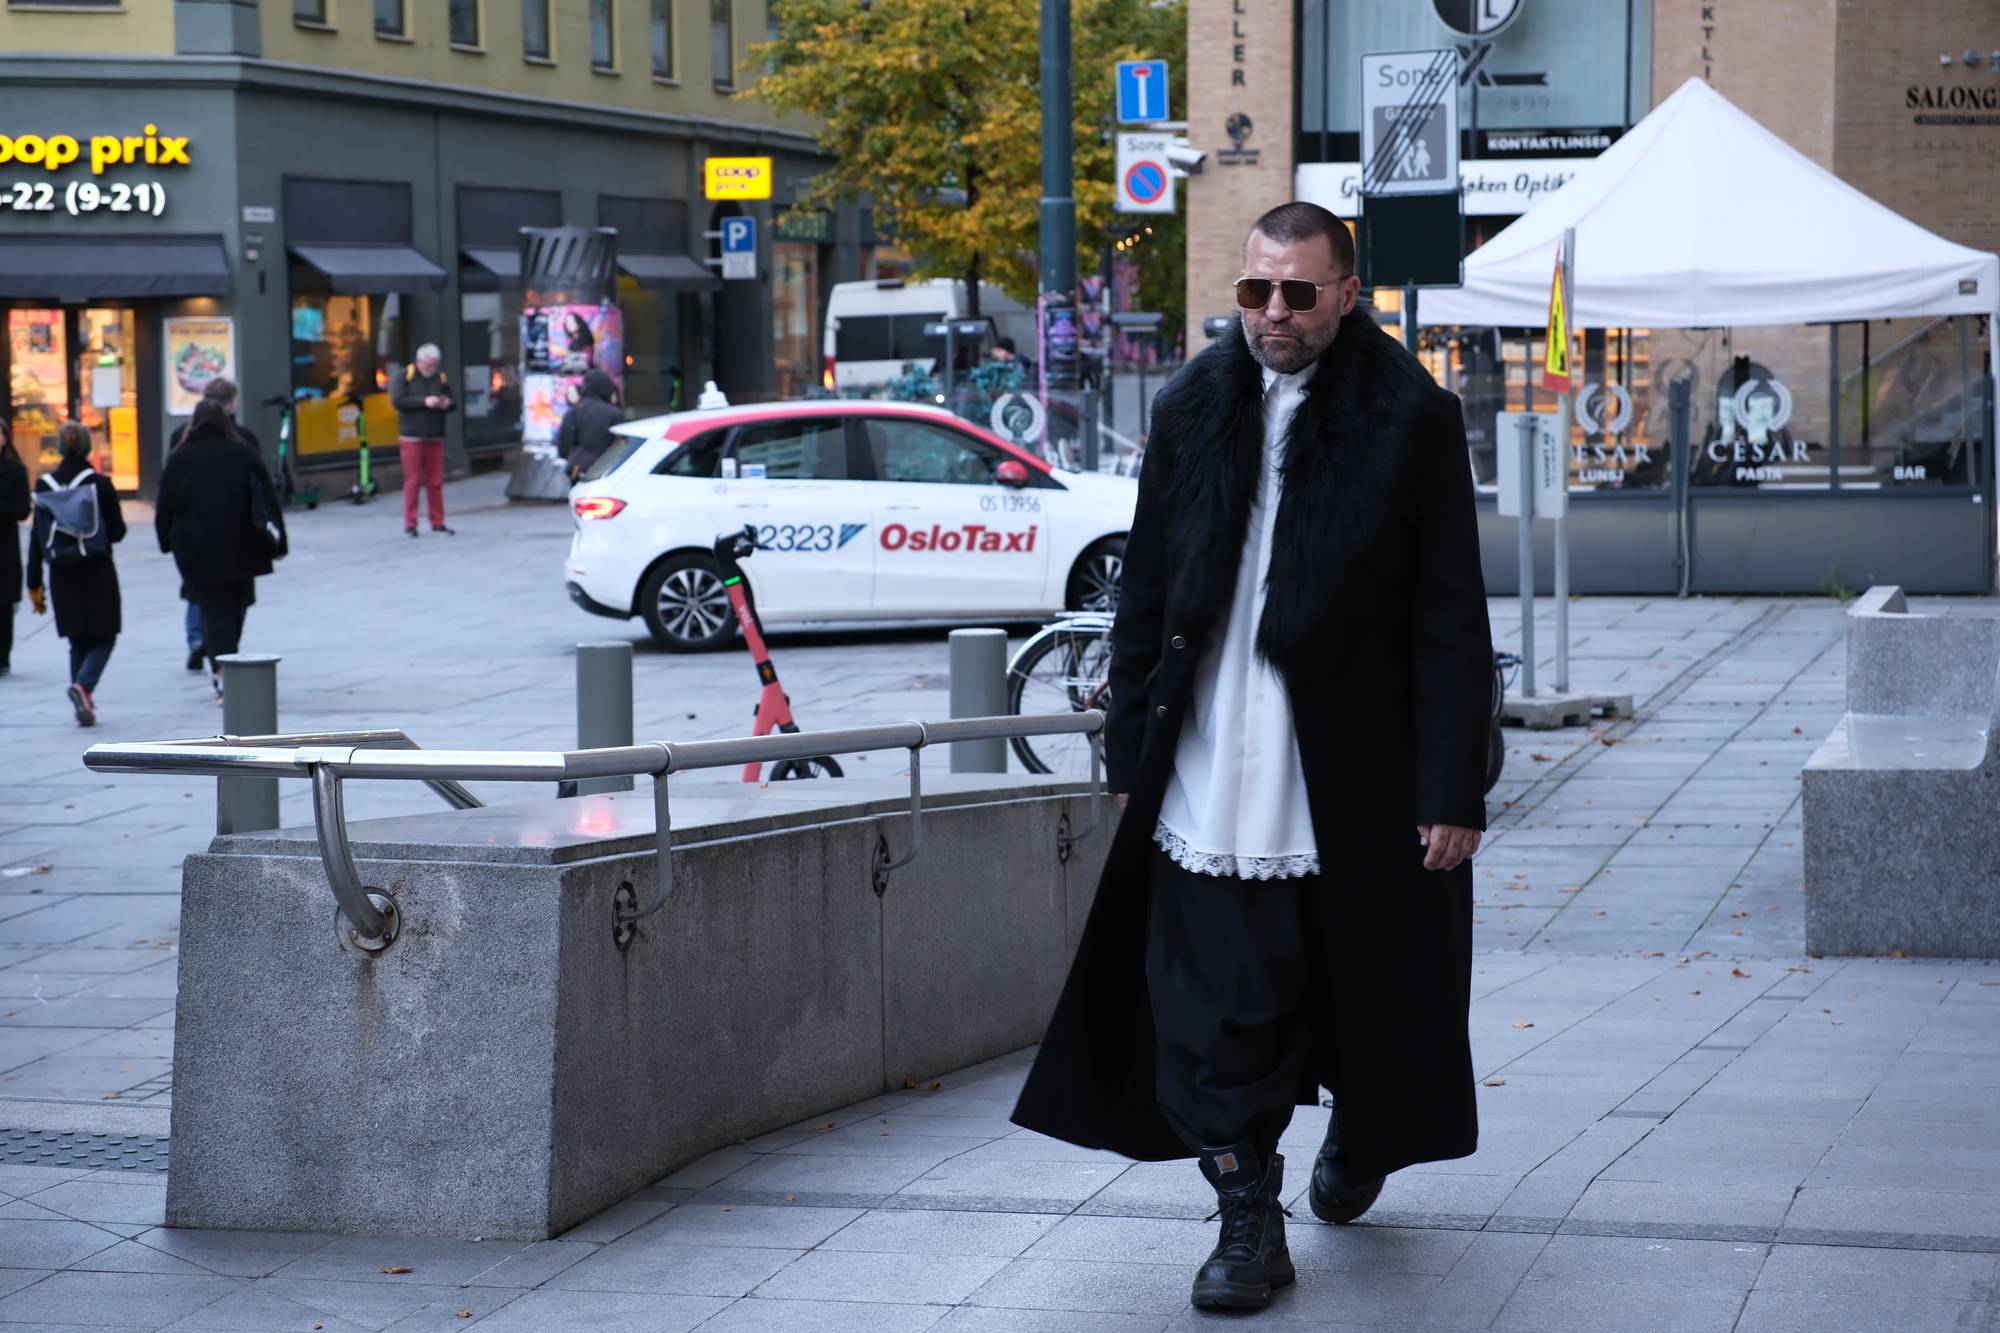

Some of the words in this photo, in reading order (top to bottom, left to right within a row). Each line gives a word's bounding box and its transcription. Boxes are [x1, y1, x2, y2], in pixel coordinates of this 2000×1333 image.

[1378, 65, 1440, 87] Sone
[1906, 85, 2000, 109] SALONG
[90, 123, 192, 174] prix
[1487, 136, 1611, 151] KONTAKTLINSER
[0, 181, 55, 211] -22
[65, 180, 166, 216] (9-21)
[1513, 172, 1575, 200] Optik
[728, 221, 748, 249] P
[1708, 435, 1811, 463] CÉSAR
[1736, 466, 1783, 481] PASTA
[1893, 465, 1926, 481] BAR
[750, 524, 834, 551] 2323
[879, 522, 1038, 552] OsloTaxi
